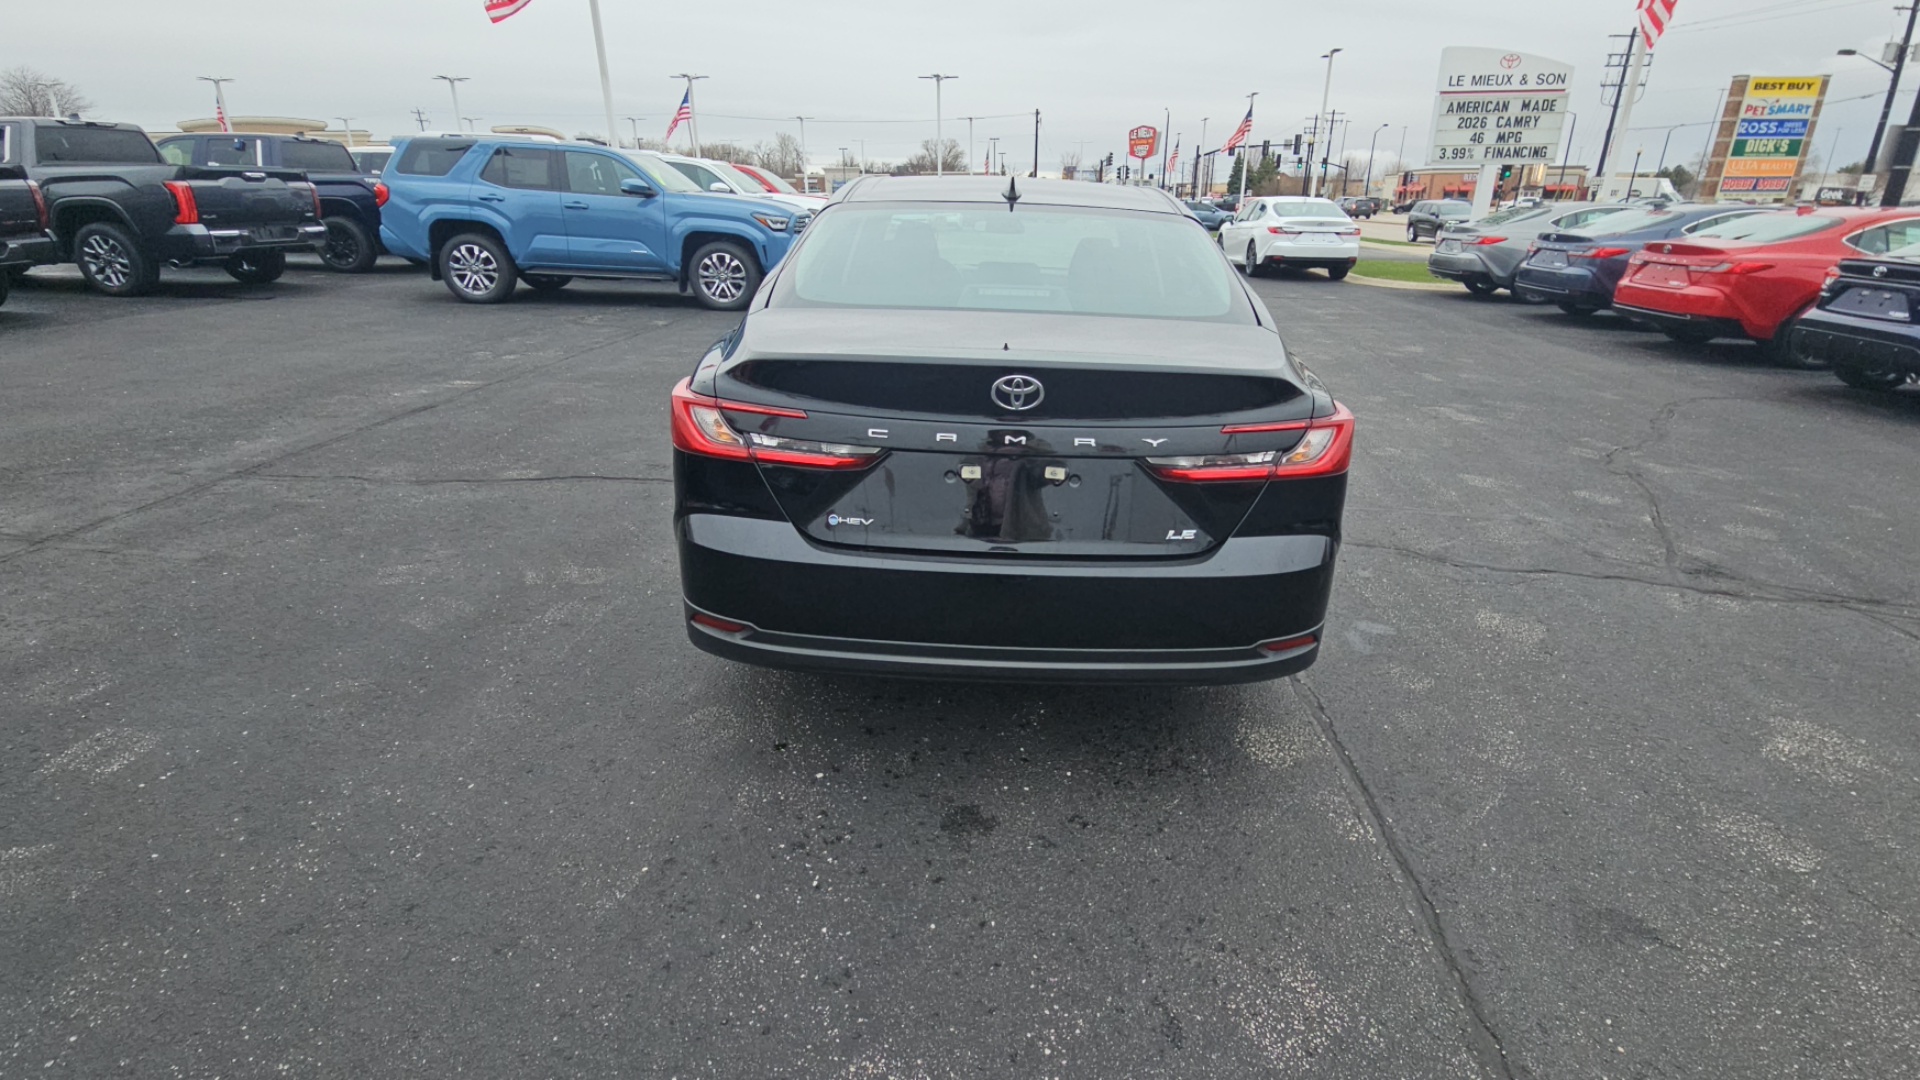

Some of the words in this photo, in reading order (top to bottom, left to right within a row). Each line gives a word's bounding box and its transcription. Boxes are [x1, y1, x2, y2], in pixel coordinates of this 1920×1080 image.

[1448, 75, 1465, 87] LE
[1470, 74, 1513, 87] MIEUX
[1519, 73, 1528, 85] &
[1535, 73, 1567, 85] SON
[1753, 82, 1785, 90] BEST
[1787, 82, 1815, 90] BUY
[1446, 100, 1510, 114] AMERICAN
[1520, 99, 1557, 112] MADE
[1457, 116, 1487, 129] 2026
[1496, 115, 1541, 128] CAMRY
[1738, 122, 1778, 134] ROSS
[1469, 132, 1485, 144] 46
[1495, 131, 1523, 144] MPG
[1745, 139, 1790, 152] DICK'S
[1439, 147, 1475, 160] 3.99%
[1483, 146, 1548, 159] FINANCING
[868, 428, 1168, 447] CAMRY
[1165, 529, 1198, 540] LE
